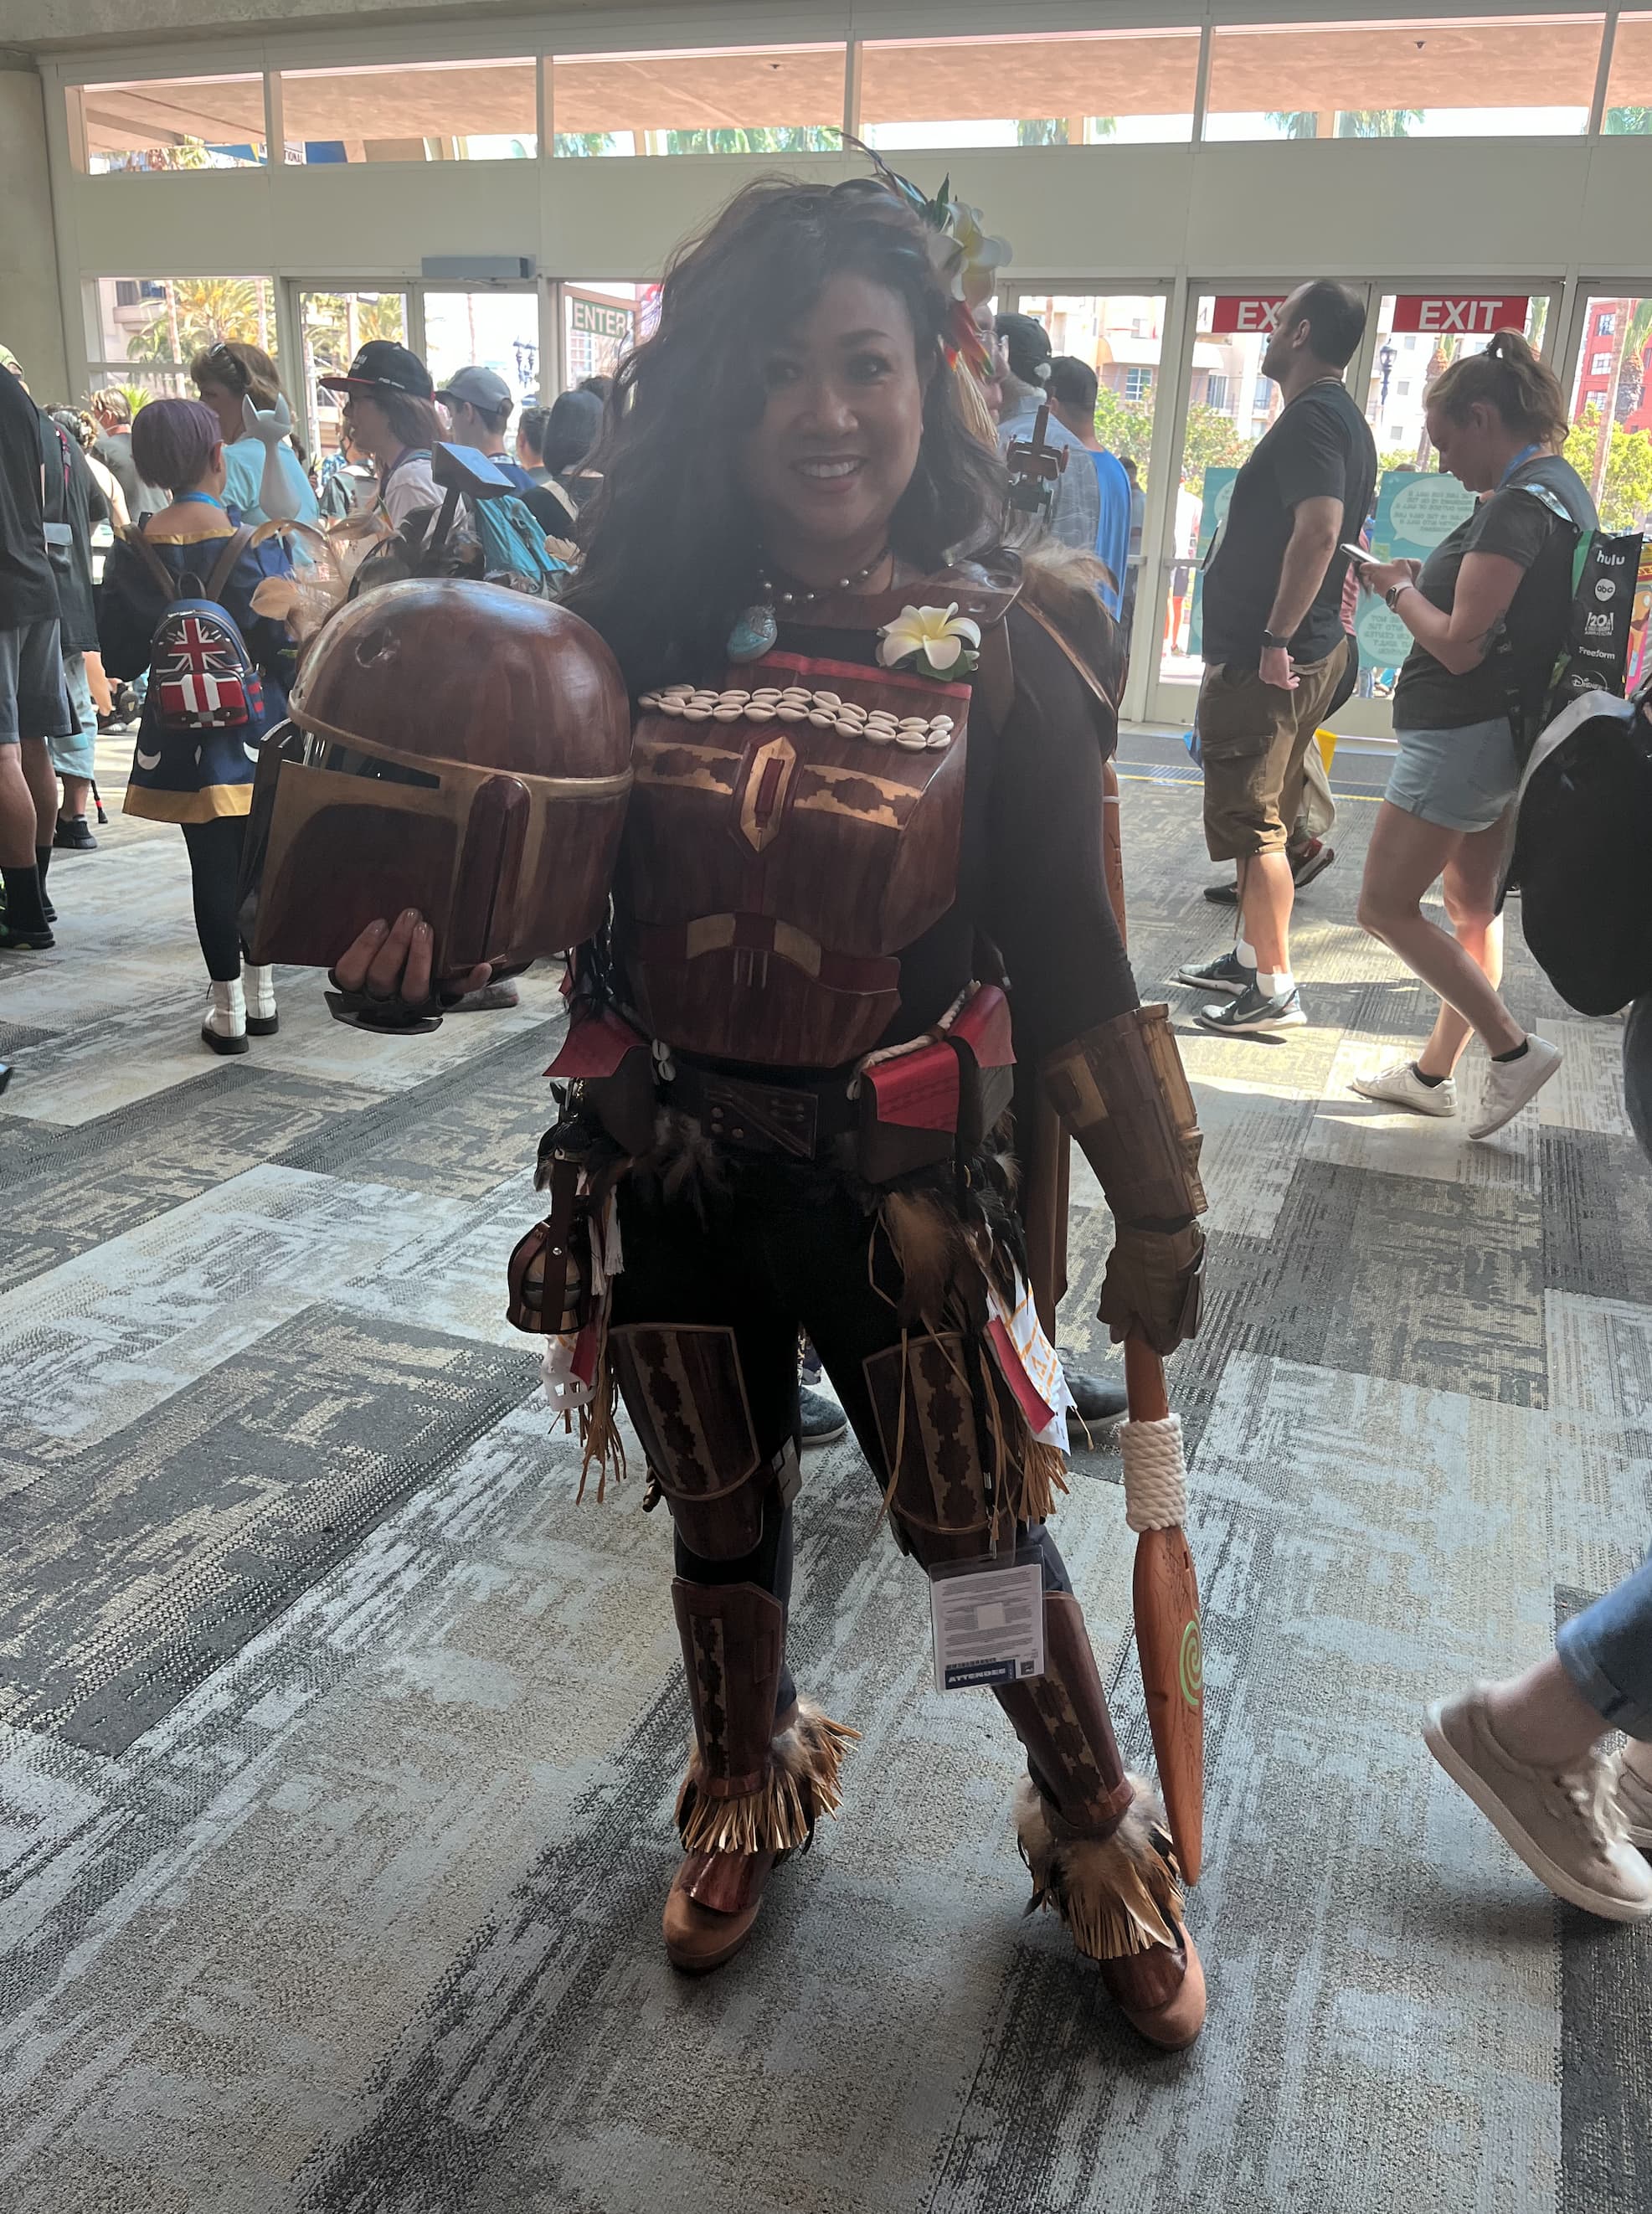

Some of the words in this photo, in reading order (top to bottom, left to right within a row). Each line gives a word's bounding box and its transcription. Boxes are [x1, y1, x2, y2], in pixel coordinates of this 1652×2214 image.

[574, 302, 626, 335] ENTER
[1238, 301, 1282, 329] EX
[1419, 301, 1503, 330] EXIT
[1597, 549, 1625, 565] hulu
[1597, 584, 1613, 594] abc
[1579, 646, 1615, 660] Freeform
[948, 1668, 1006, 1683] ATTENDEE
